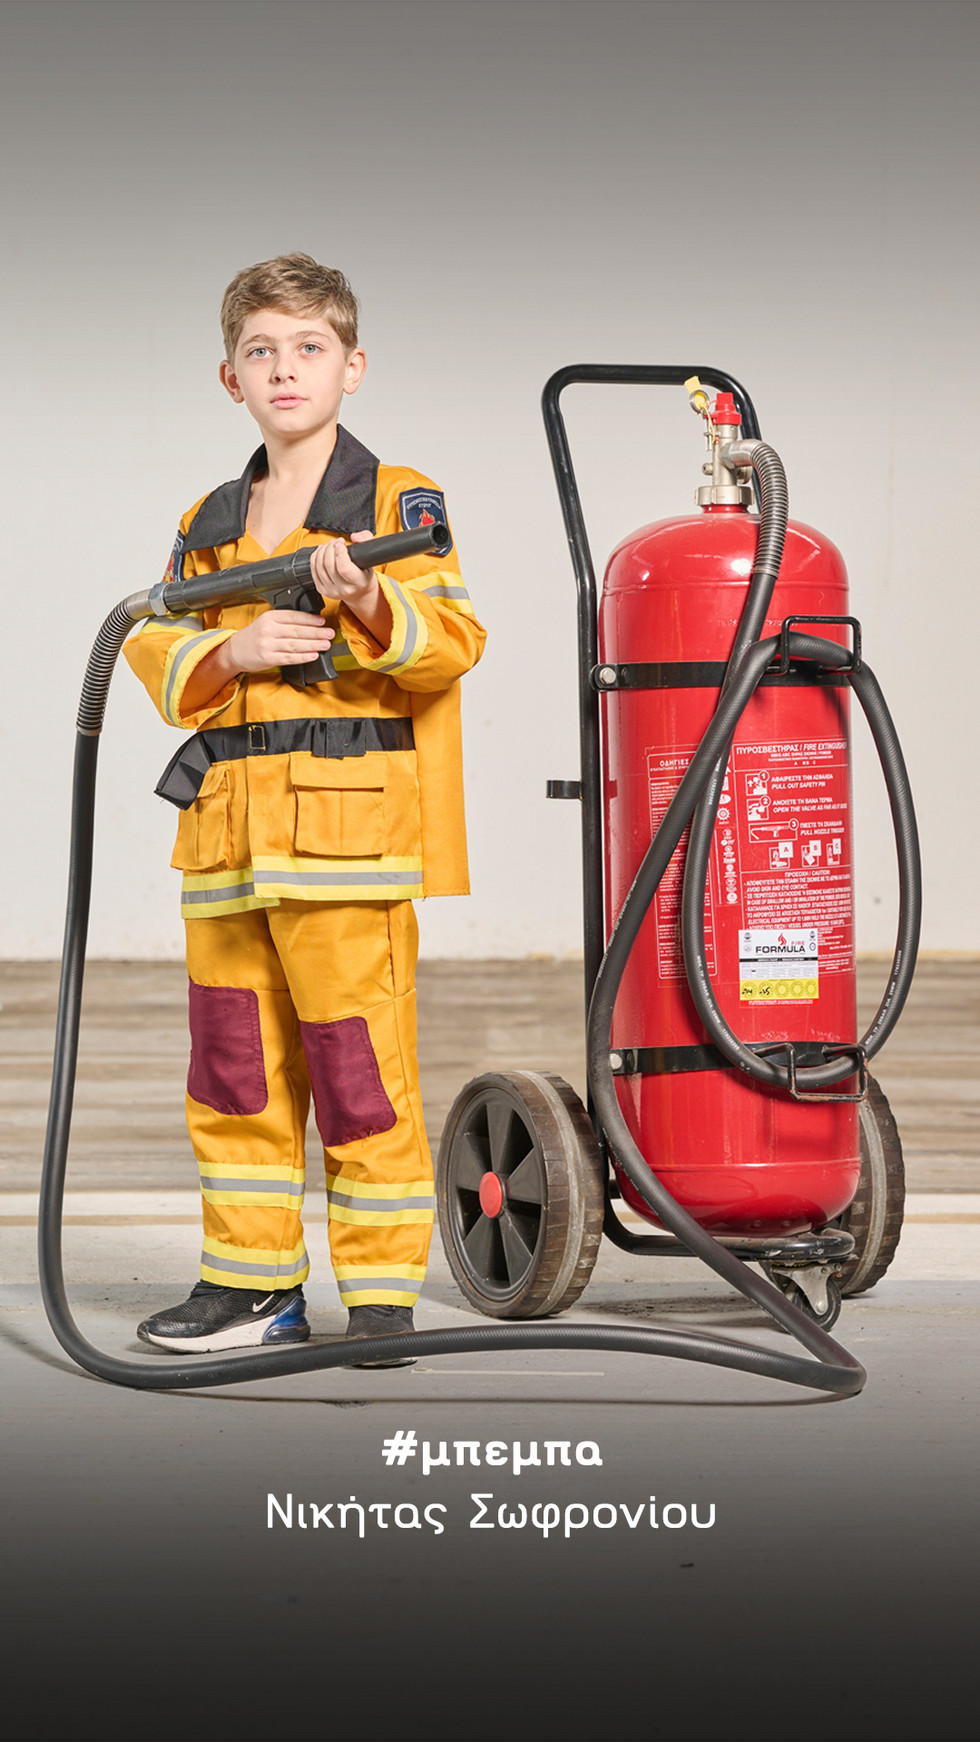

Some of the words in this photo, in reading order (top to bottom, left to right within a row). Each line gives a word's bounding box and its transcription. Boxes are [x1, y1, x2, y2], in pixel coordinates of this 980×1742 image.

[736, 744, 799, 754] ΠΥΡΟΣΒΕΣΤΗΡΑΣ
[659, 758, 689, 766] ΟΔΗΓΙΕΣ
[755, 945, 806, 954] FORMULA
